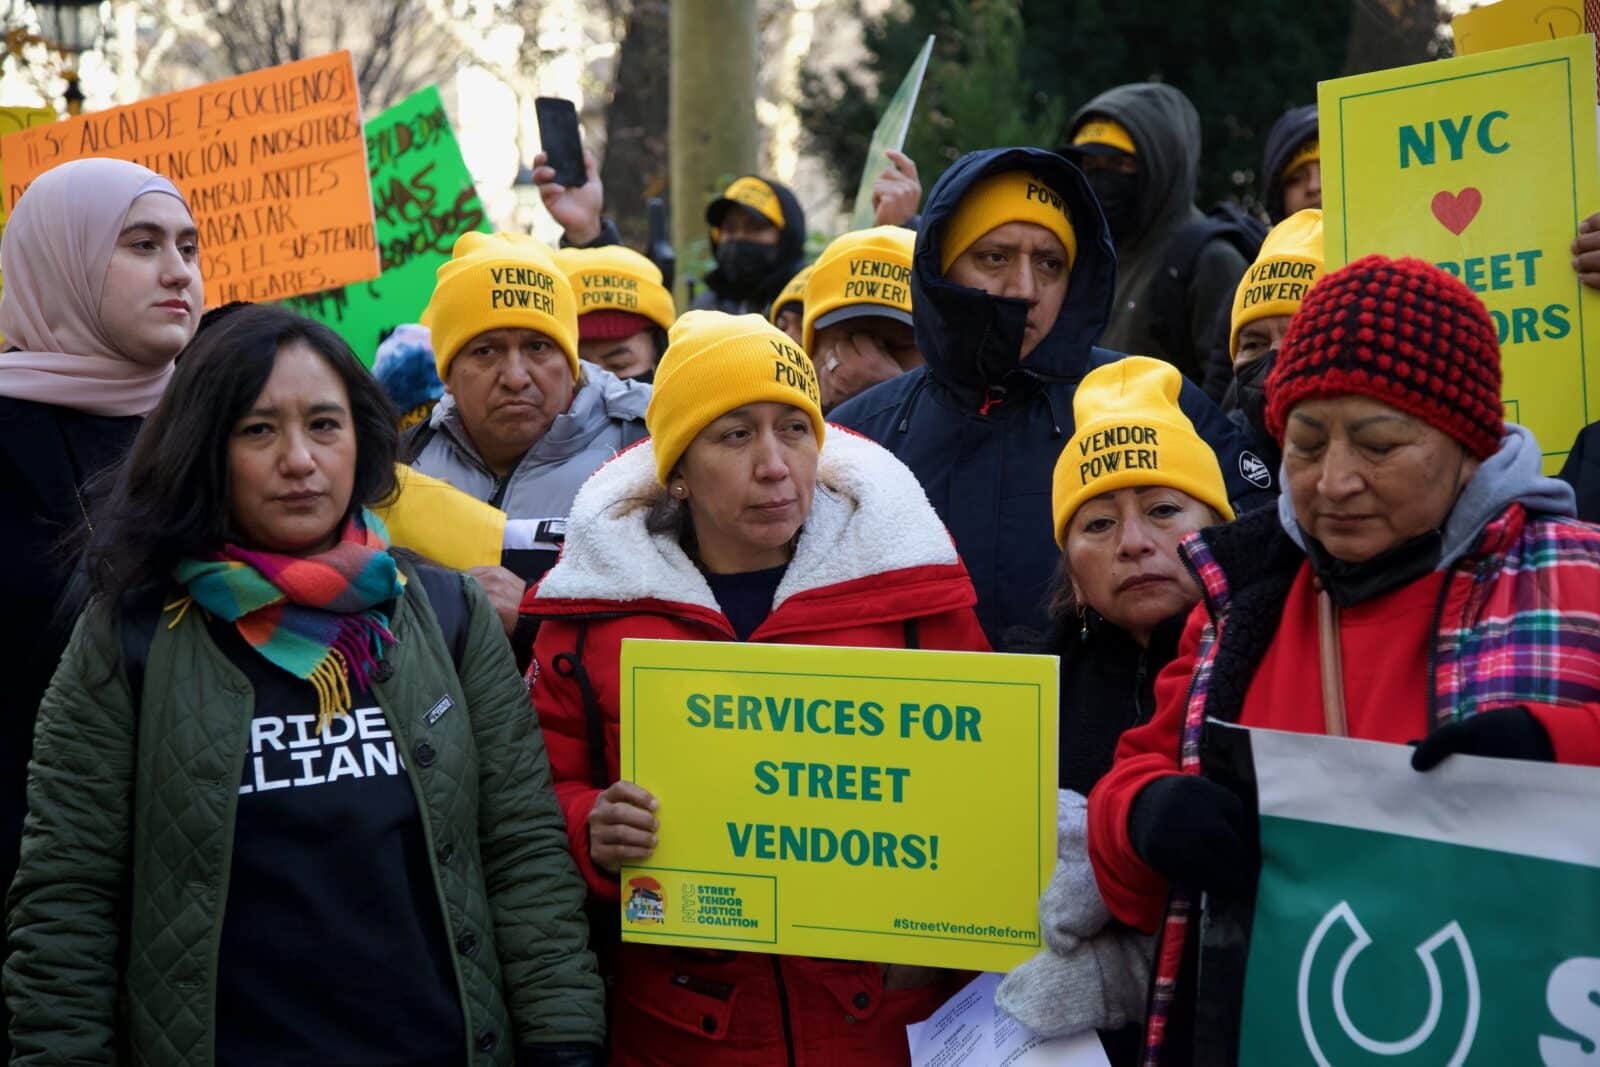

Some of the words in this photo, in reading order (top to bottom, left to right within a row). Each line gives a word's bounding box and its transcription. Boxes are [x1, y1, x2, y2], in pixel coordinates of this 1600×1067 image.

[78, 101, 184, 154] ALCALDE
[1399, 110, 1510, 169] NYC
[131, 129, 238, 181] TENCIÓN
[490, 267, 555, 294] VENDOR
[582, 274, 638, 292] VENDOR
[849, 259, 912, 286] VENDOR
[1250, 261, 1317, 284] VENDOR
[1436, 250, 1543, 293] EET
[491, 288, 554, 317] POWER!
[582, 290, 638, 310] POWER!
[844, 279, 907, 304] POWER!
[1079, 425, 1159, 457] VENDOR
[1080, 449, 1158, 486] POWER!
[251, 706, 393, 753] RIDE
[686, 693, 884, 737] SERVICES
[899, 703, 983, 743] FOR
[238, 741, 407, 795] LIAN
[754, 760, 912, 803] STREET
[726, 821, 940, 871] VENDORS!
[697, 885, 736, 897] STREET
[697, 895, 743, 907] VENDOR
[697, 906, 743, 917] JUSTICE
[697, 916, 759, 928] COALITION
[893, 918, 1036, 940] #StreetVendorReform
